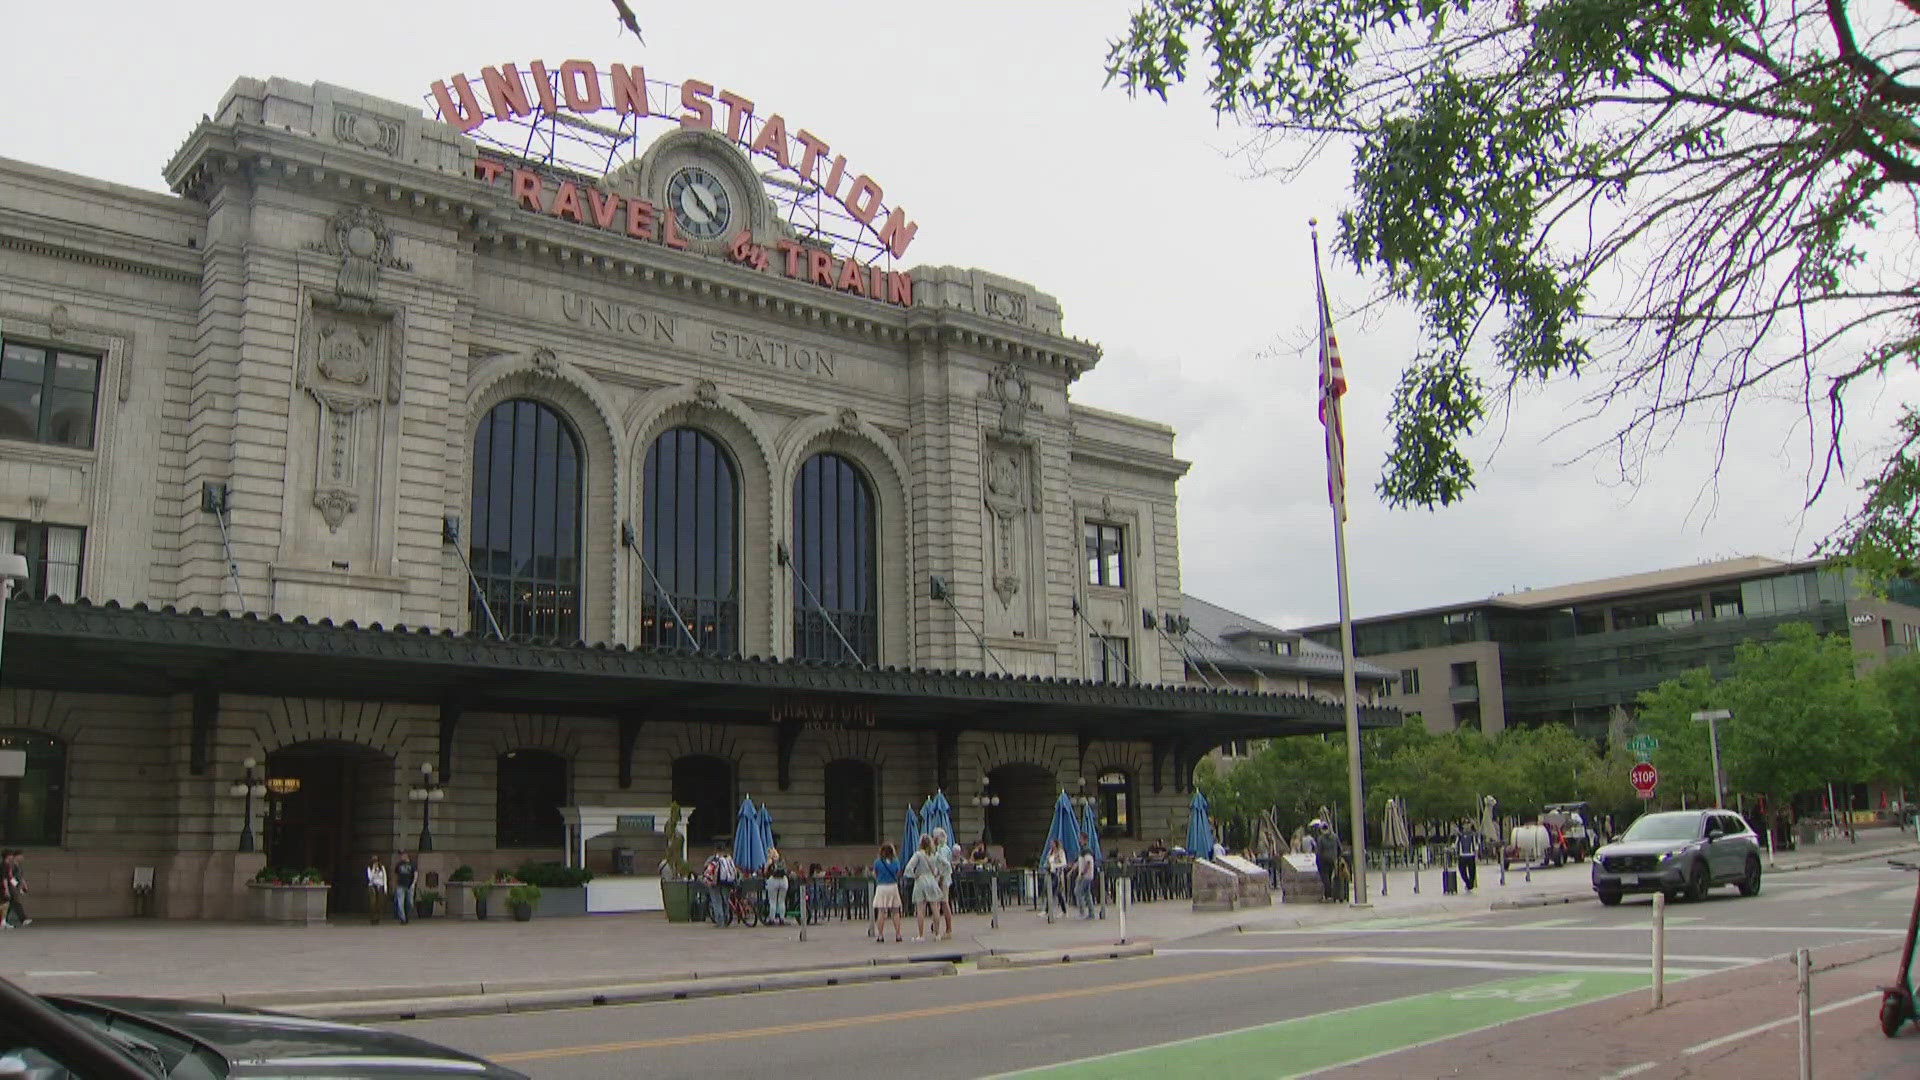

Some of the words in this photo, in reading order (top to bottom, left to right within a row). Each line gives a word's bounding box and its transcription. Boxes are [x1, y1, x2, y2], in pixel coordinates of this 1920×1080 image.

[430, 59, 649, 134] UNION
[680, 79, 918, 260] STATION
[475, 158, 689, 250] TRAVEL
[724, 229, 770, 272] by
[777, 239, 913, 308] TRAIN
[562, 293, 677, 344] UNION
[710, 330, 836, 378] STATION
[1854, 615, 1872, 623] IMA
[1632, 771, 1654, 784] STOP
